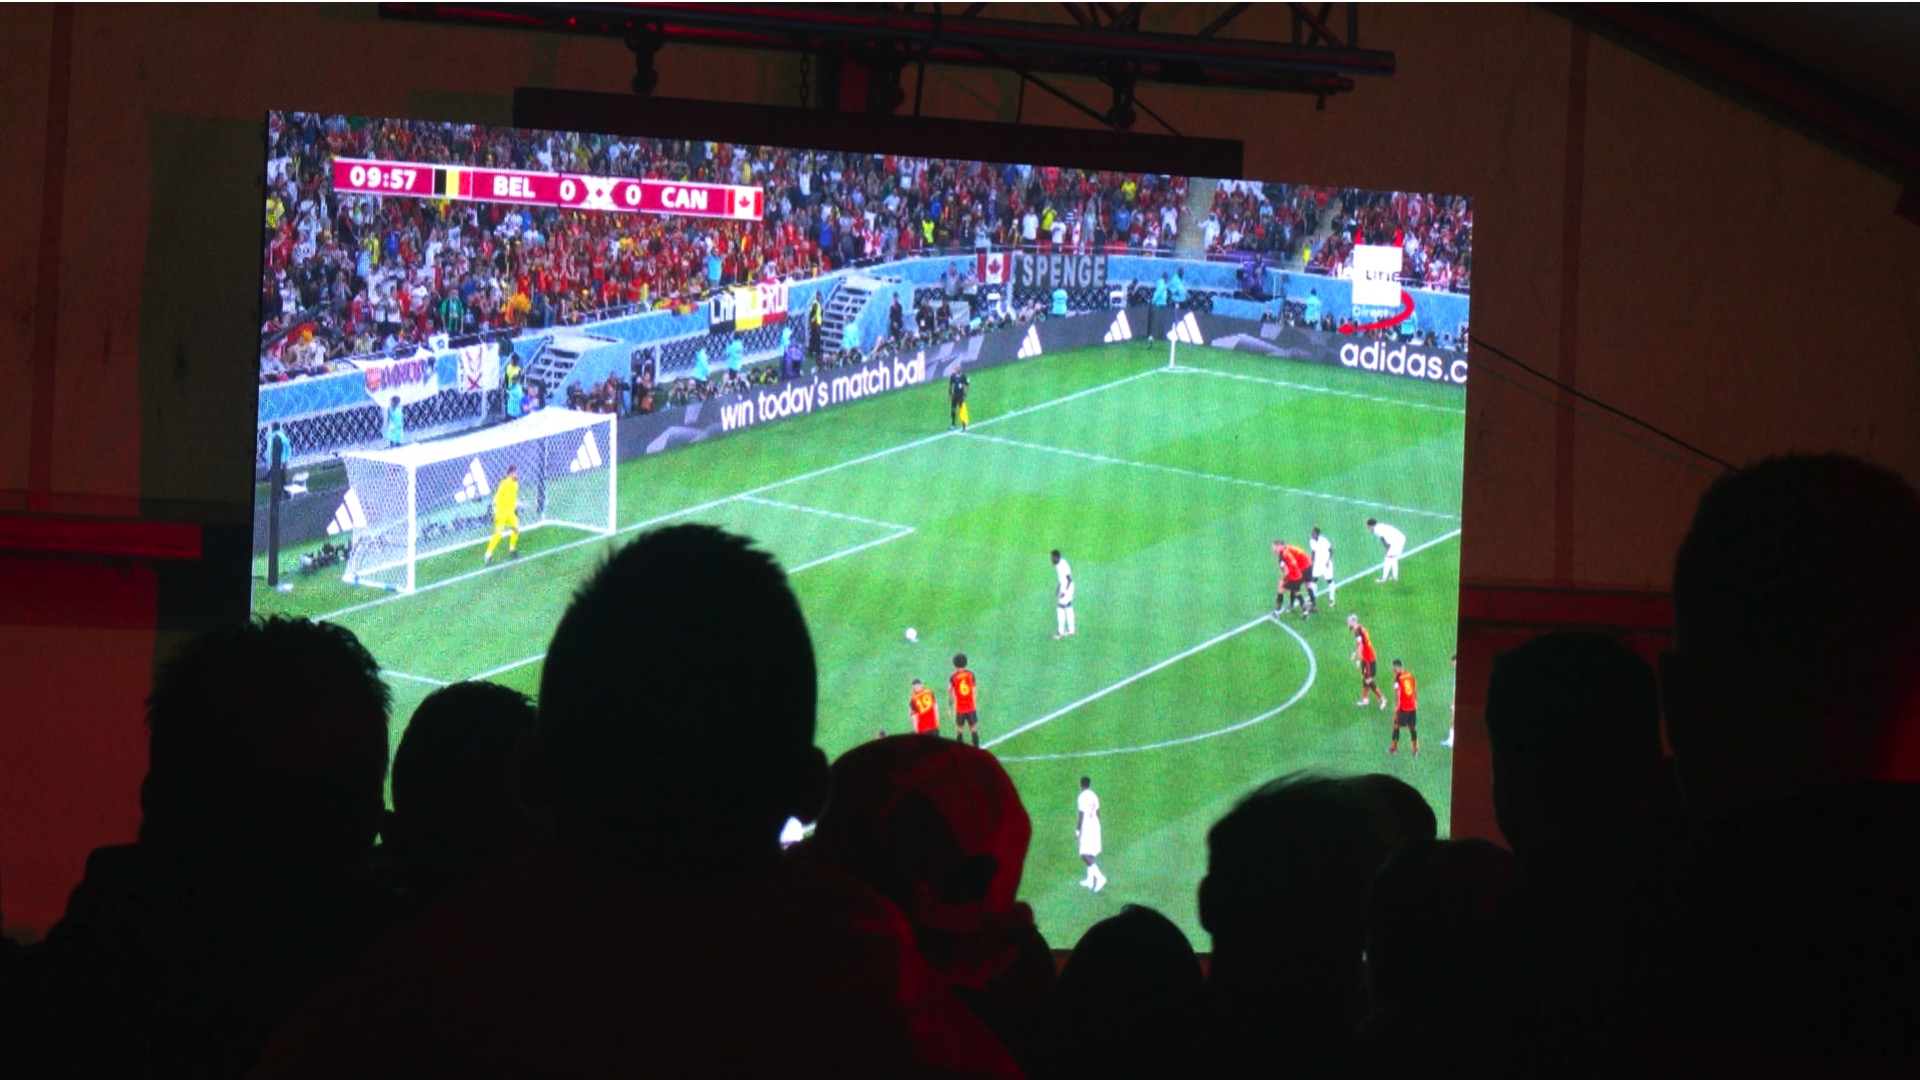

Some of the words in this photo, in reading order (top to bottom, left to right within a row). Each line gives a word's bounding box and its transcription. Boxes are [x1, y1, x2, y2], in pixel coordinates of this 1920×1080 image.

[350, 166, 417, 190] 09:57
[493, 175, 536, 199] BEL
[560, 179, 576, 200] 0
[625, 184, 641, 206] 0
[661, 187, 708, 210] CAN
[1022, 253, 1105, 287] SPENGE
[720, 394, 754, 431] win
[758, 376, 829, 422] today's
[832, 361, 890, 404] match
[894, 350, 926, 388] ball
[916, 693, 933, 714] 19
[959, 679, 970, 696] 6
